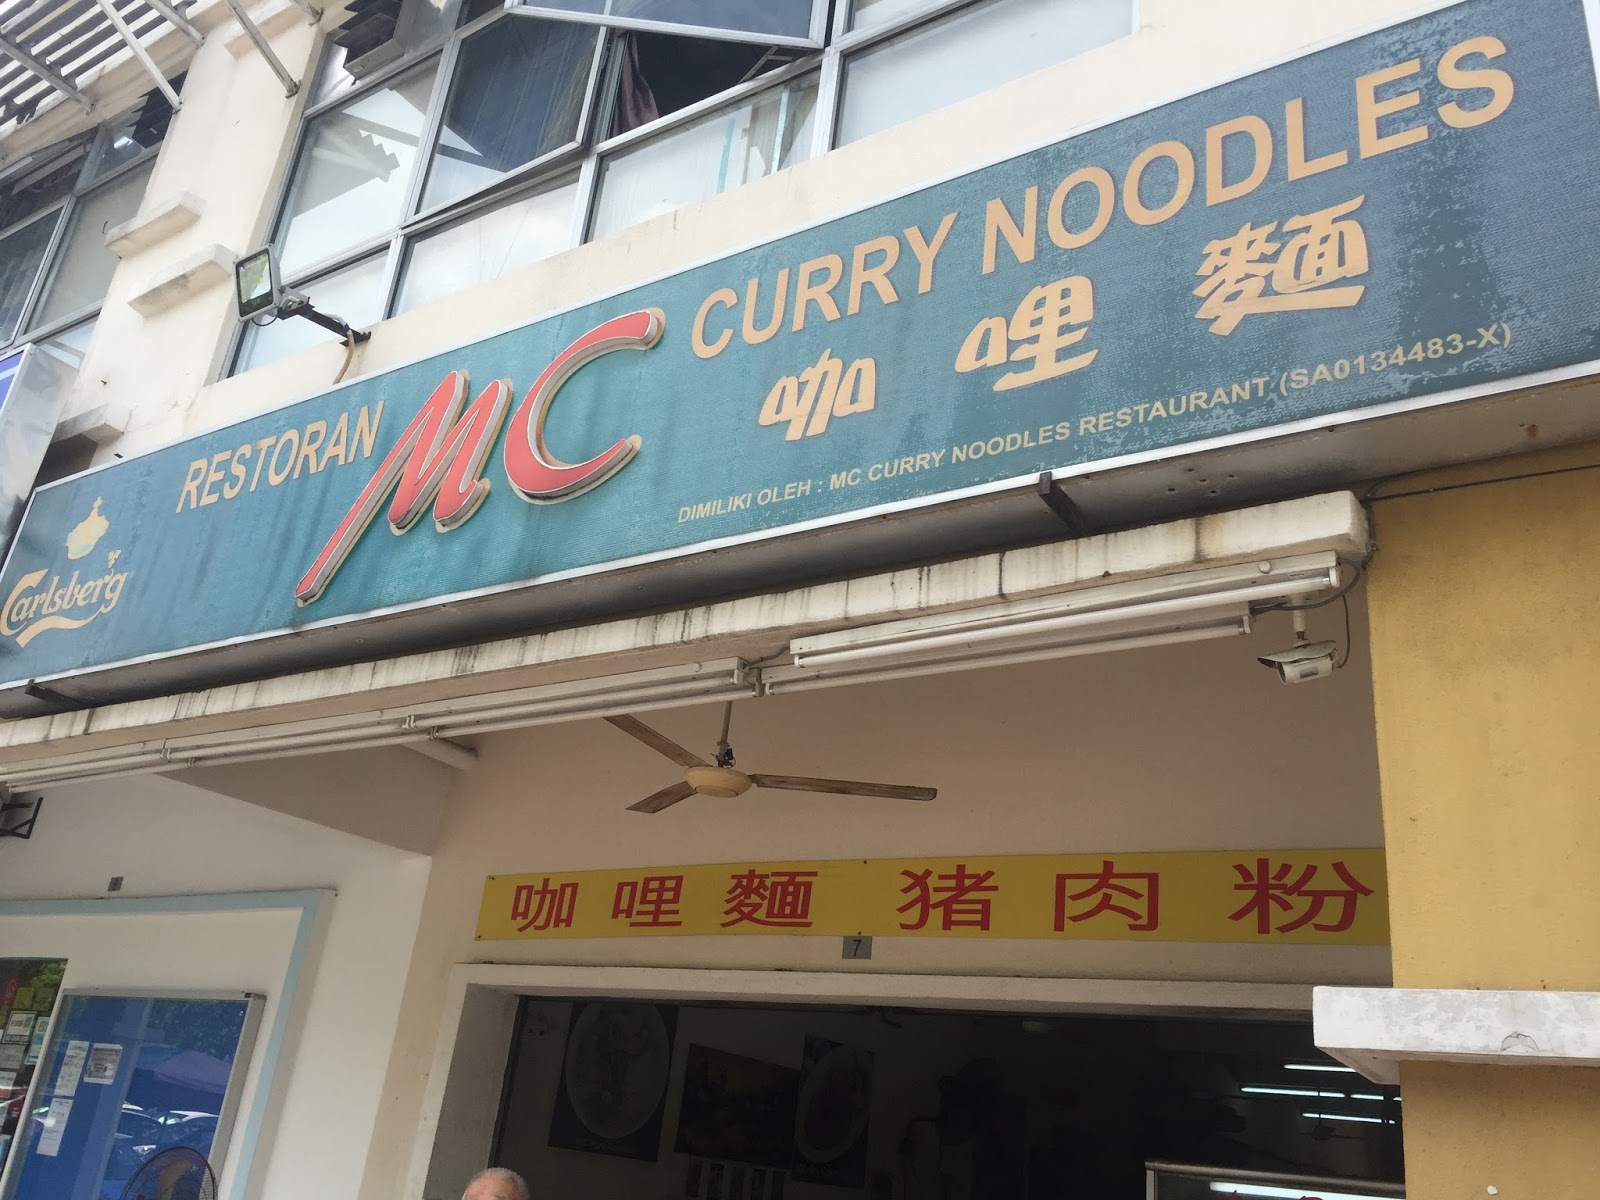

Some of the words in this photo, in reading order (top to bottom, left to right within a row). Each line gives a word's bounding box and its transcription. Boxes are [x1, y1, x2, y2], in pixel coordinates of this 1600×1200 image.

[176, 400, 385, 514] RESTORAN
[295, 307, 666, 608] MC
[690, 212, 959, 360] CURRY
[981, 36, 1515, 275] NOODLES
[677, 492, 752, 523] DIMILIKI
[757, 479, 812, 506] OLEH
[829, 468, 862, 491] MC
[867, 449, 946, 481] CURRY
[951, 422, 1071, 463] NOODLES
[1079, 377, 1270, 436] RESTAURANT
[1280, 322, 1512, 397] (SA0134483-X)
[0, 562, 128, 641] Carlsberg
[851, 938, 863, 958] 7
